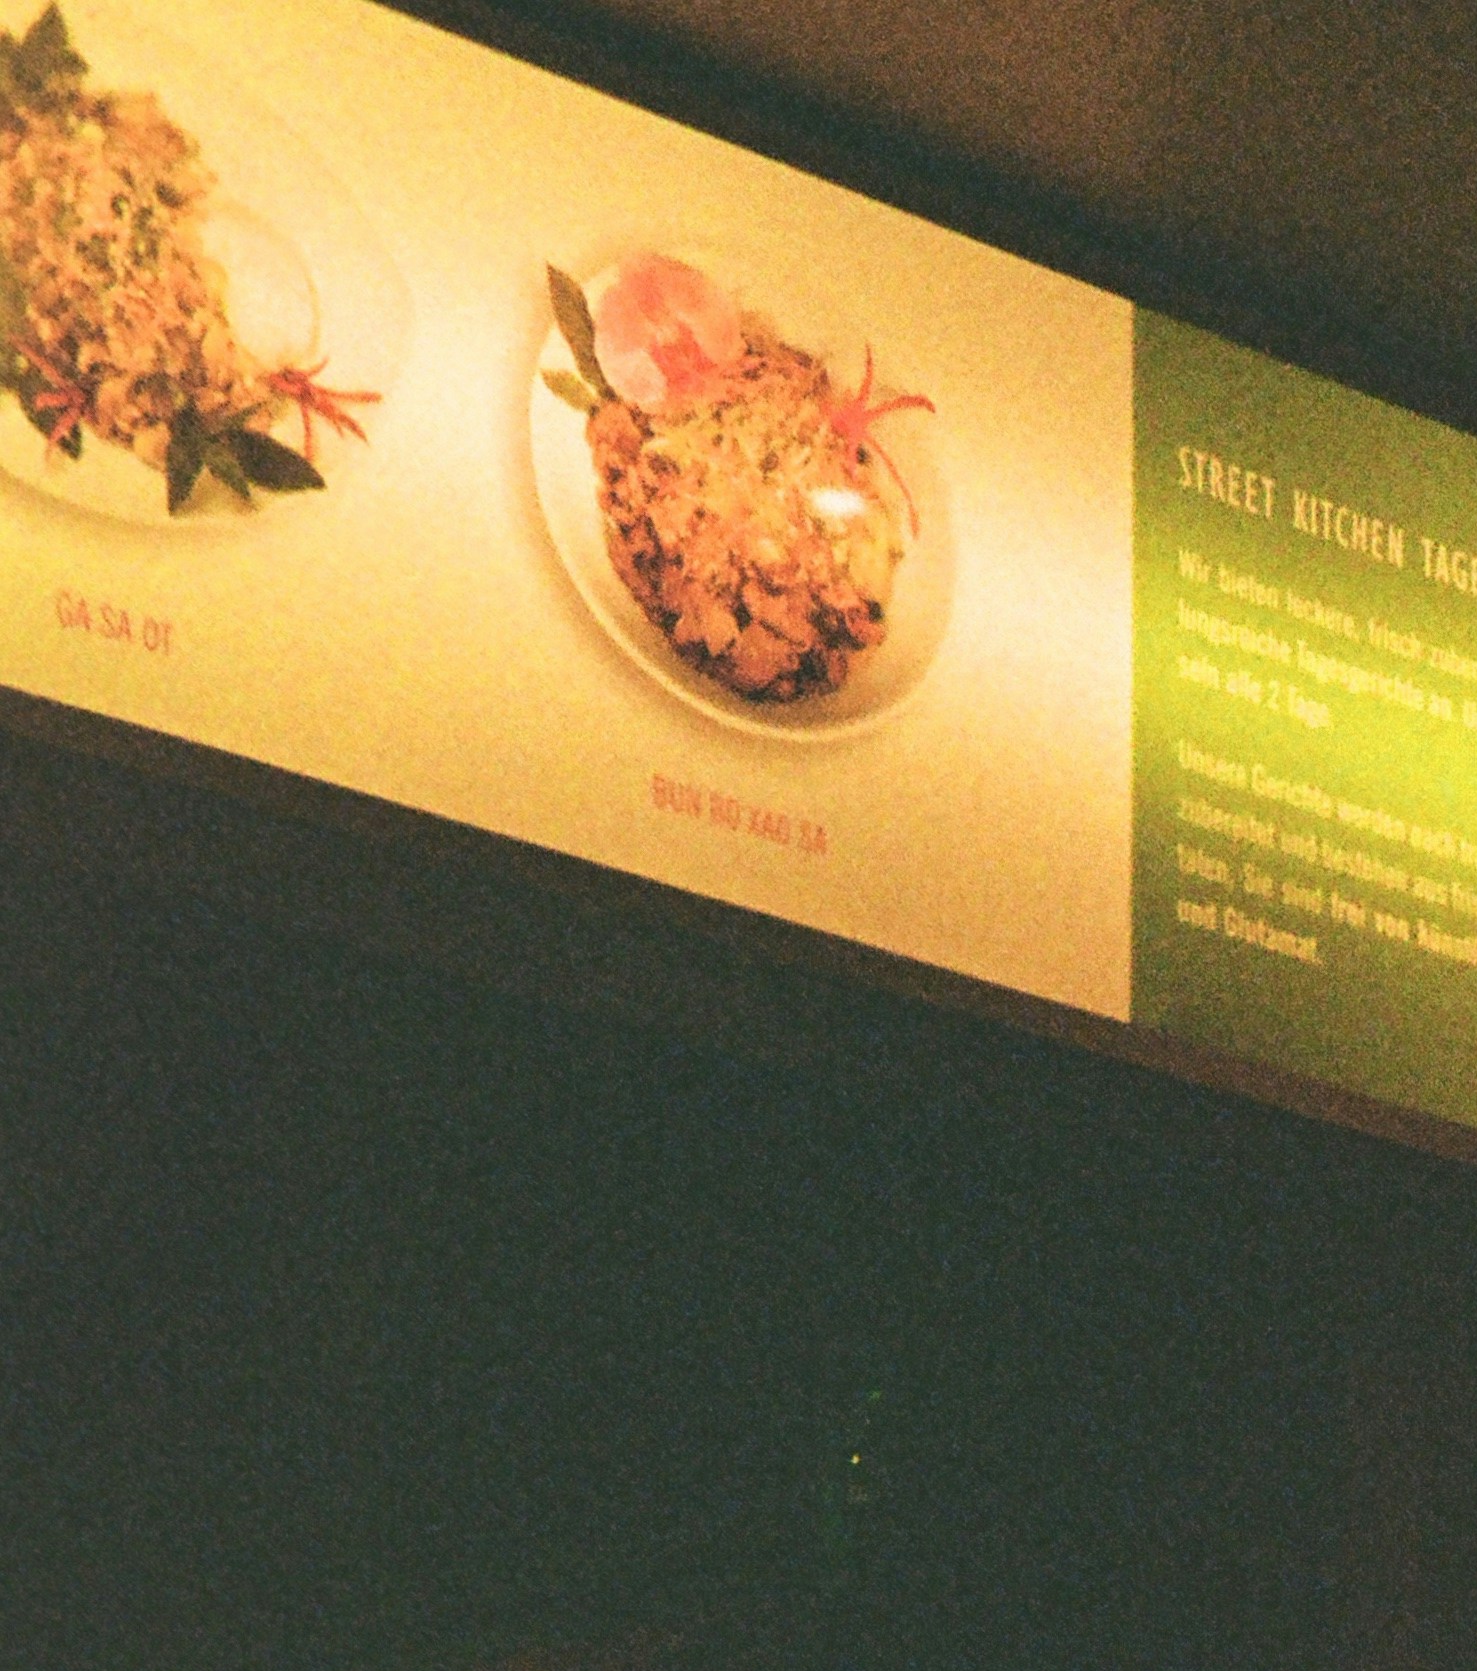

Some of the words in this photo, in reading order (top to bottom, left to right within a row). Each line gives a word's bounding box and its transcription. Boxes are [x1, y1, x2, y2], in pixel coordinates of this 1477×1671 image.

[1177, 443, 1274, 520] STREET
[1293, 487, 1404, 569] KITCHEN
[1178, 546, 1211, 586] Wir
